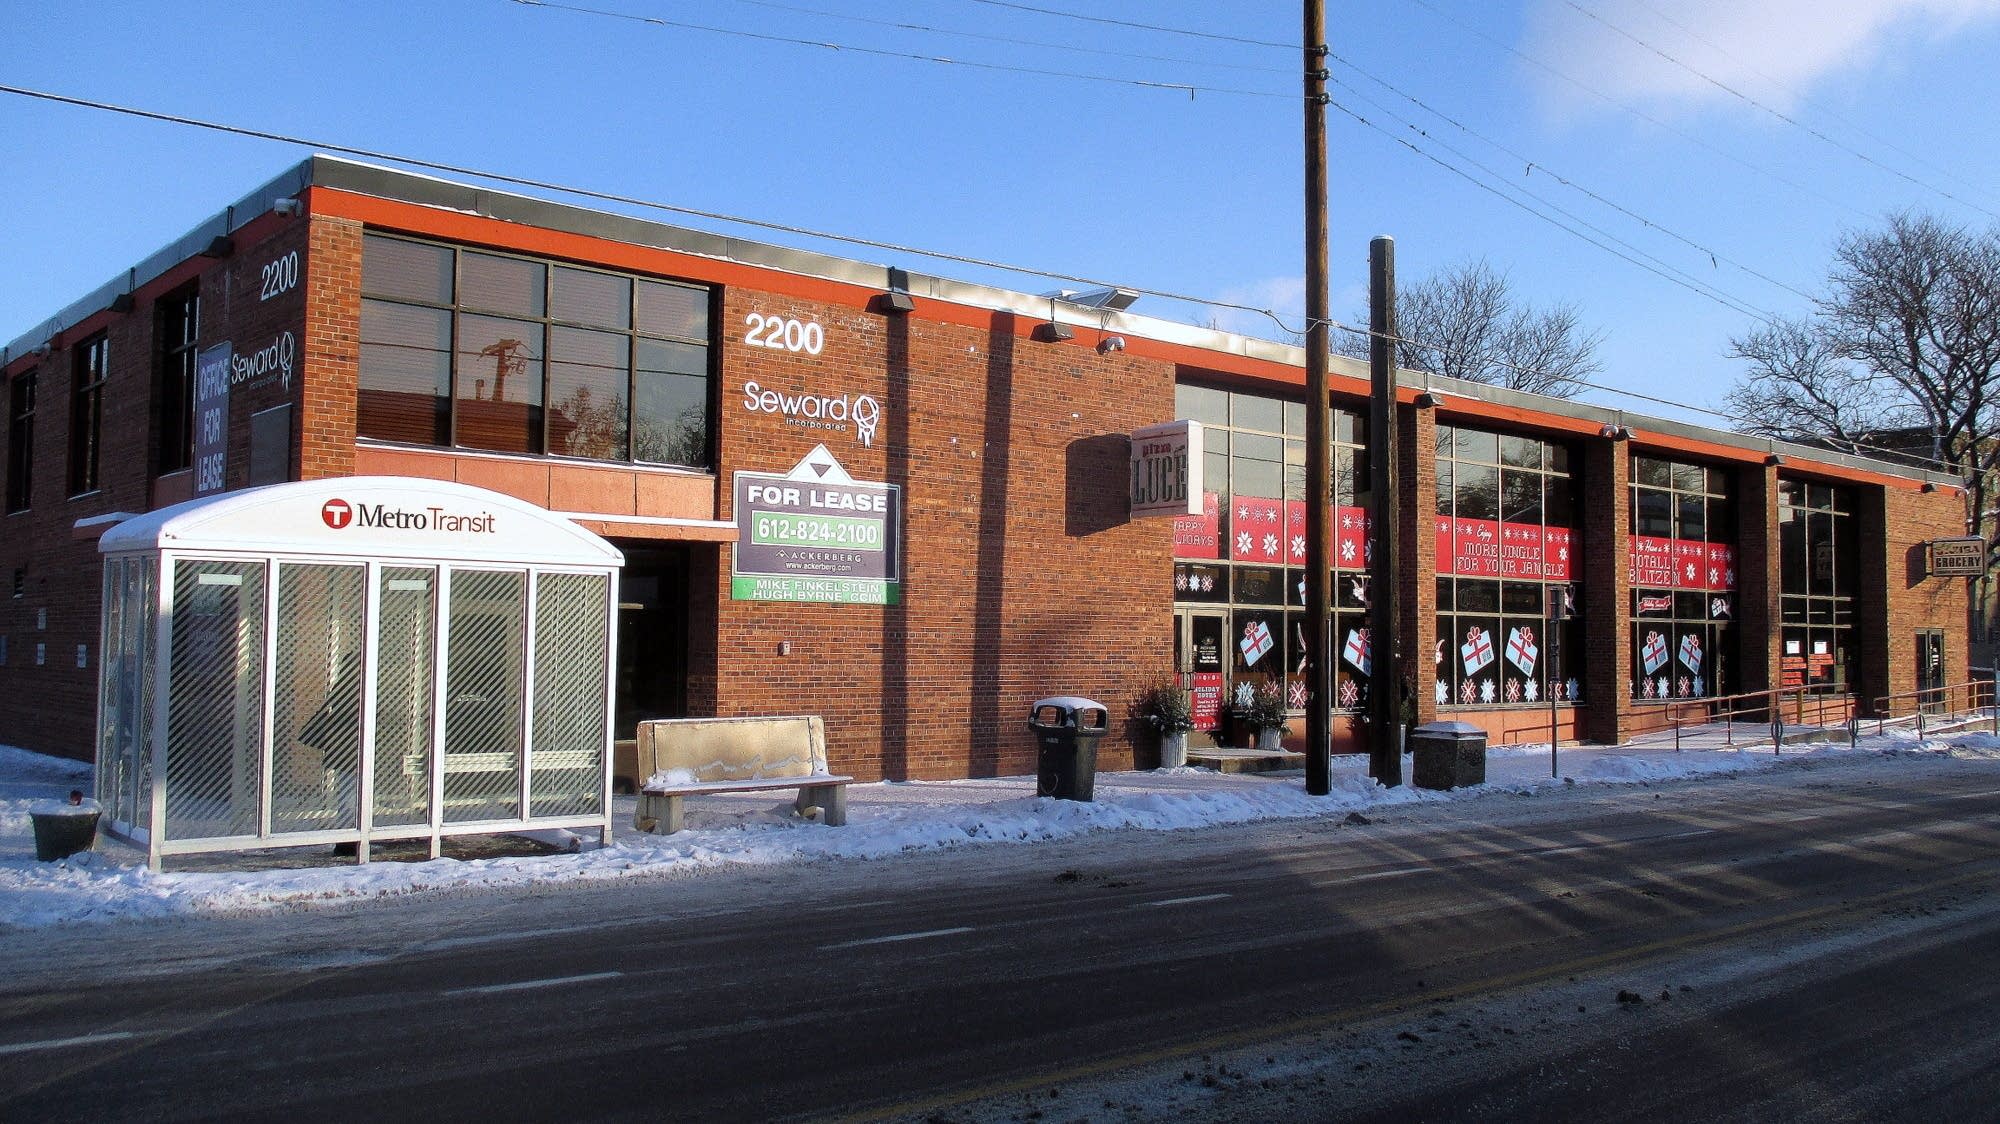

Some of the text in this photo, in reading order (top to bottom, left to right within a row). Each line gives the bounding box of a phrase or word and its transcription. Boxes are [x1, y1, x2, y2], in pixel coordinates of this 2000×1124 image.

[261, 250, 299, 301] 2200
[744, 312, 824, 355] 2200
[231, 337, 279, 385] Seward
[200, 358, 229, 402] OFFICE
[743, 381, 847, 421] Seward
[204, 407, 221, 445] FOR
[786, 417, 847, 432] incorporated
[199, 452, 224, 492] LEASE
[747, 485, 888, 512] FOR LEASE
[758, 517, 878, 545] 612-824-2100
[1174, 534, 1215, 547] LIDAYS
[791, 551, 862, 563] ACKERBERG
[1464, 542, 1540, 560] MORE JINGLE
[785, 562, 852, 573] www.ackerberg.com
[1456, 556, 1565, 577] FOR YOUR JANGLE
[1629, 553, 1681, 570] TOTALLY
[1935, 556, 1982, 568] GROCERY
[756, 579, 880, 593] MIKE FINKELSTEIN
[1628, 568, 1681, 586] BLITZEN
[752, 590, 793, 600] HUGH
